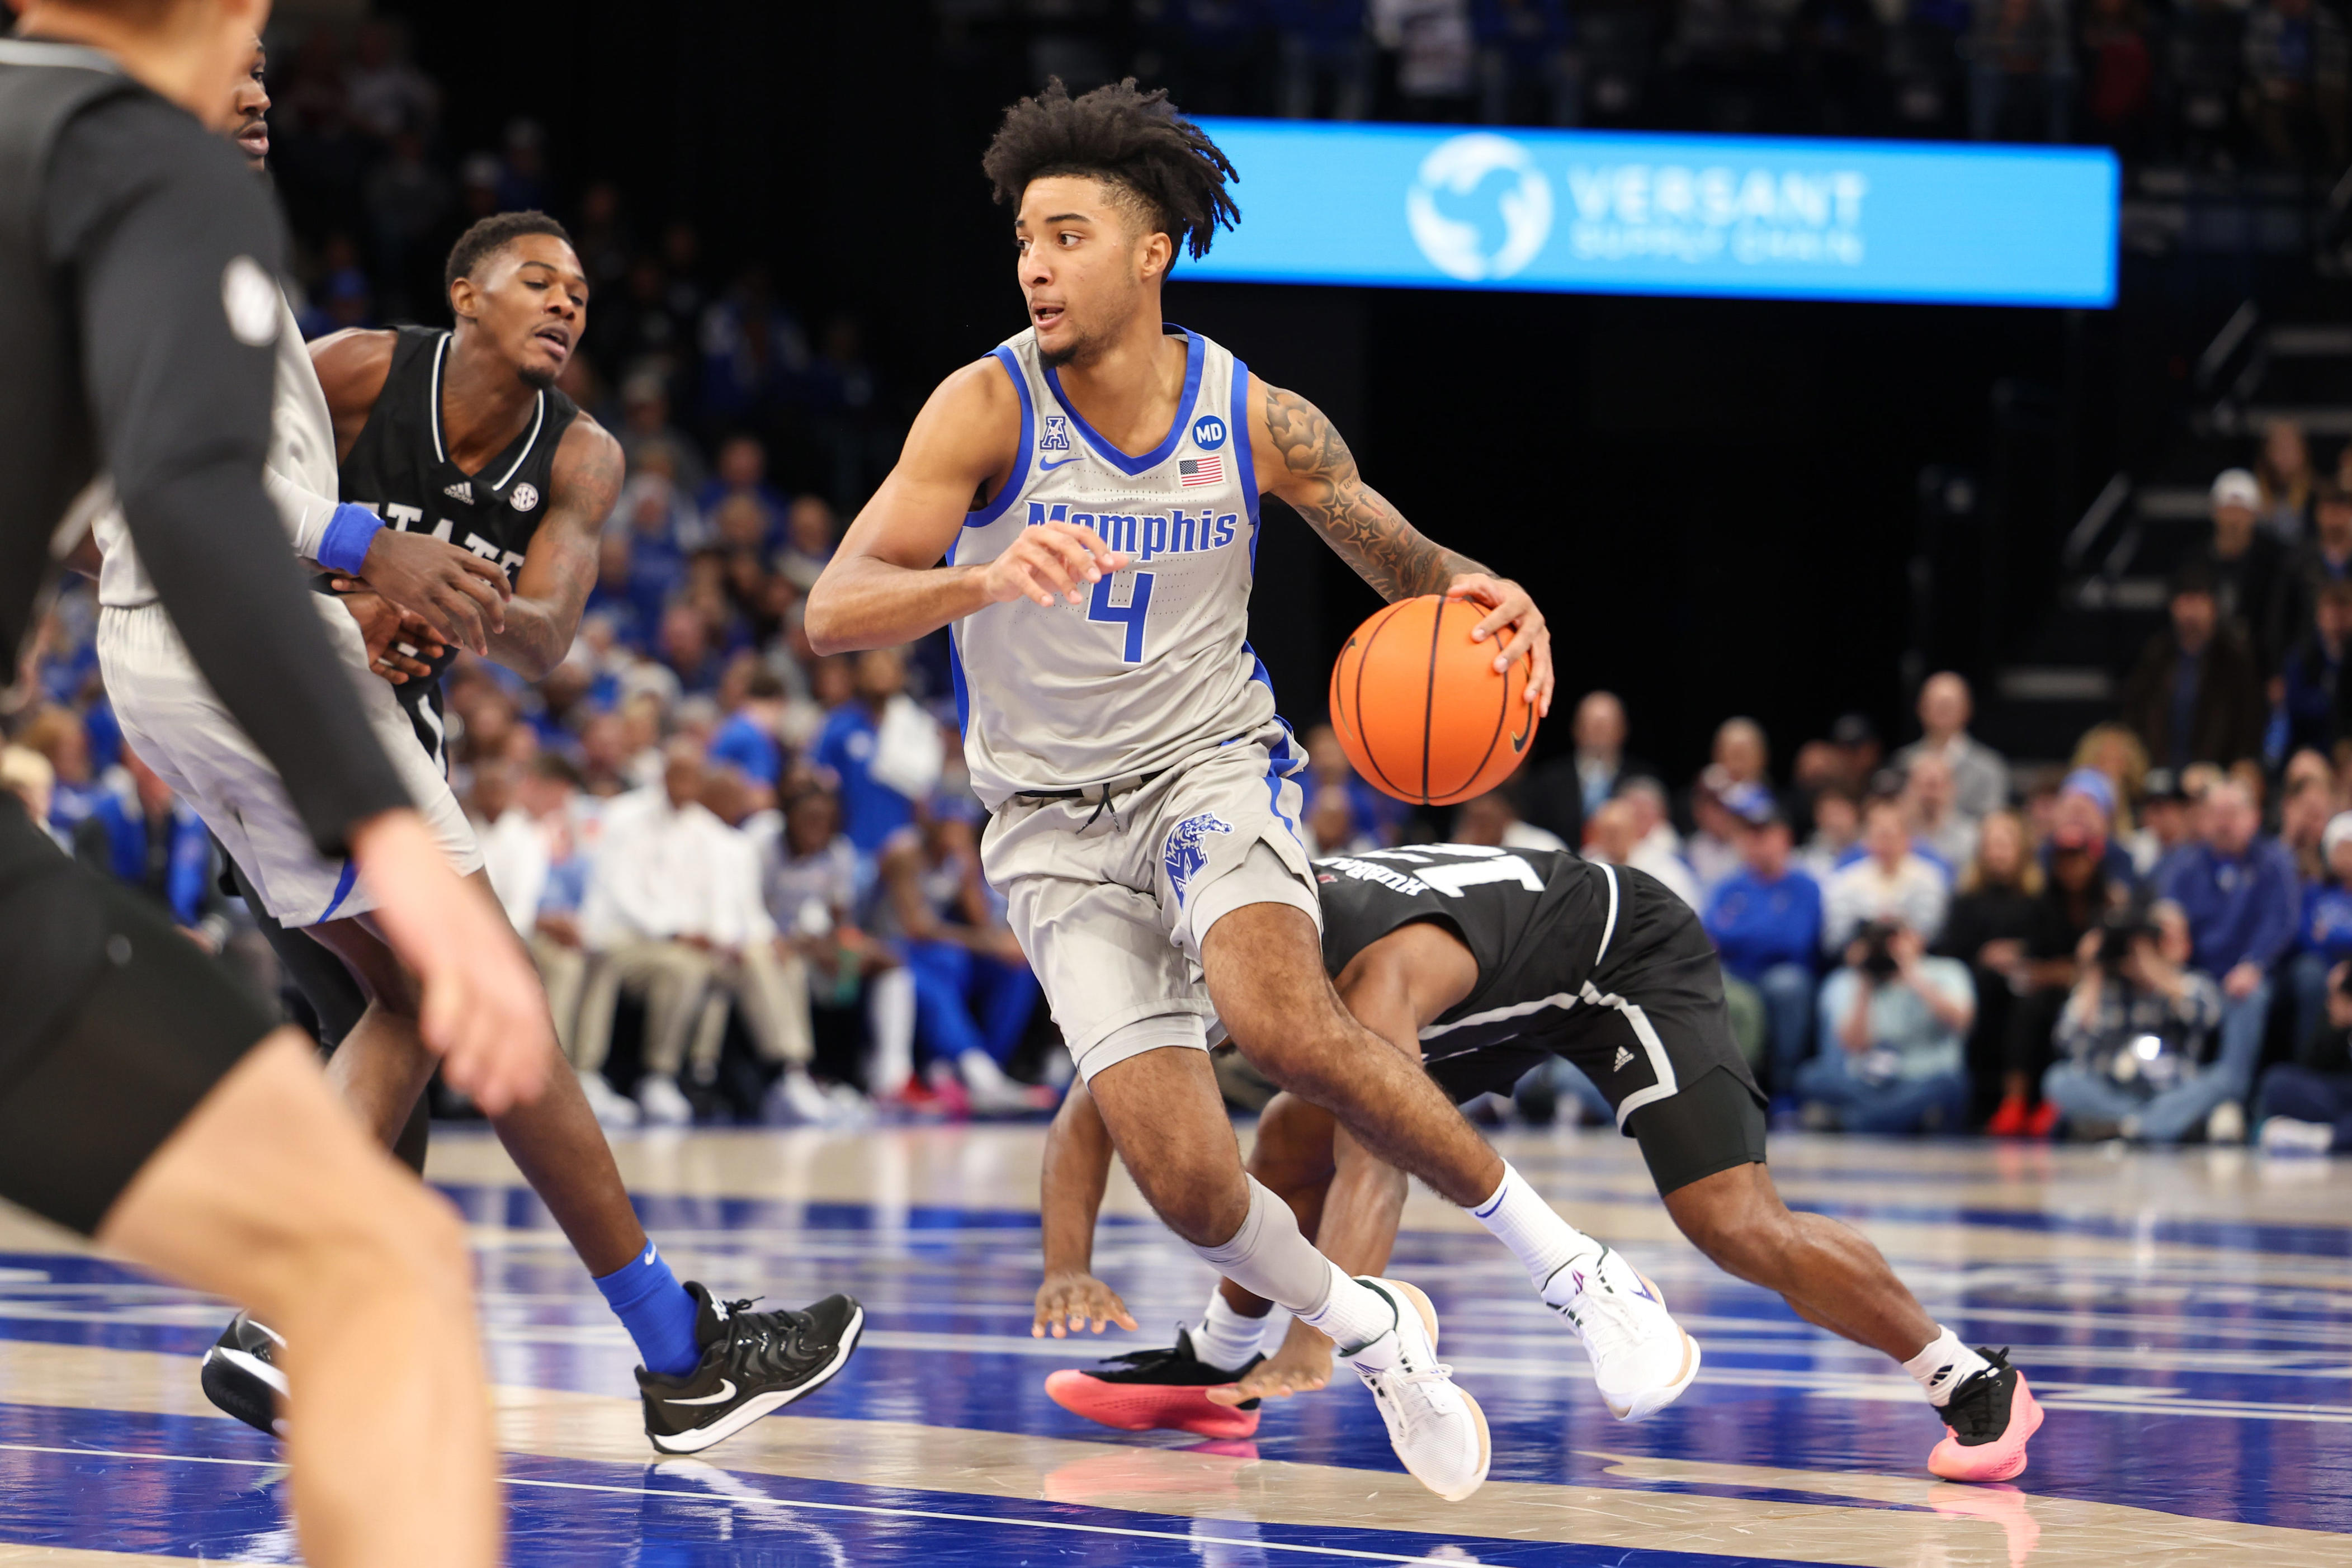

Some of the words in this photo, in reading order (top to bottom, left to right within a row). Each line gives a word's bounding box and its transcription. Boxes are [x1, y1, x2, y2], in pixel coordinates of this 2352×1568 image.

[1568, 164, 1867, 226] VERSANT
[1196, 423, 1223, 443] MD
[513, 485, 536, 509] SEC
[1024, 500, 1239, 563] Mmphis
[1085, 570, 1156, 665] 4
